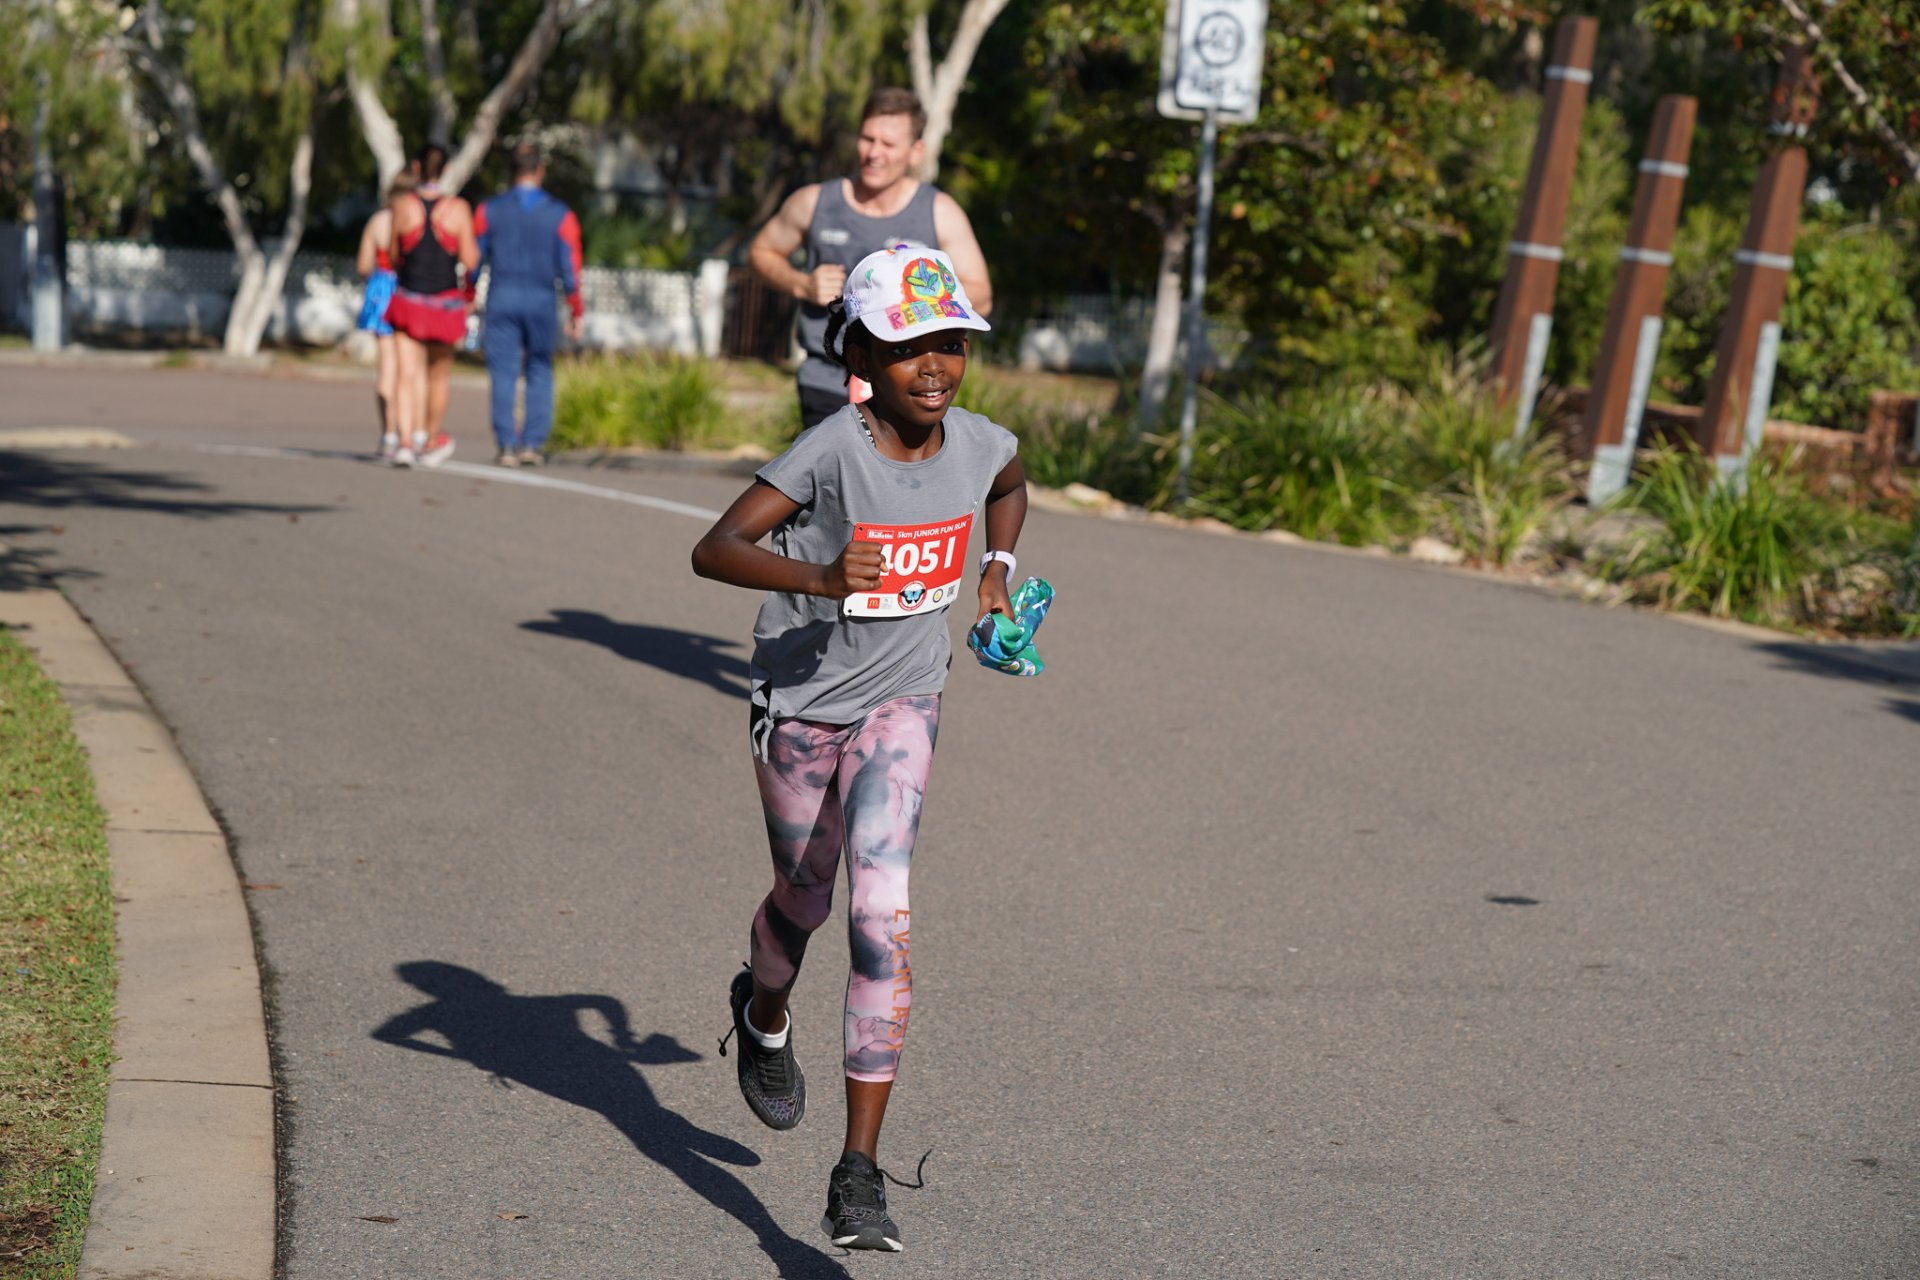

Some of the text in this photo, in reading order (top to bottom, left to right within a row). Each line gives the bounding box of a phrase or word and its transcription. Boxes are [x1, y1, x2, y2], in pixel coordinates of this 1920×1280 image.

[897, 521, 967, 539] 5km JUNIOR FUN RUN
